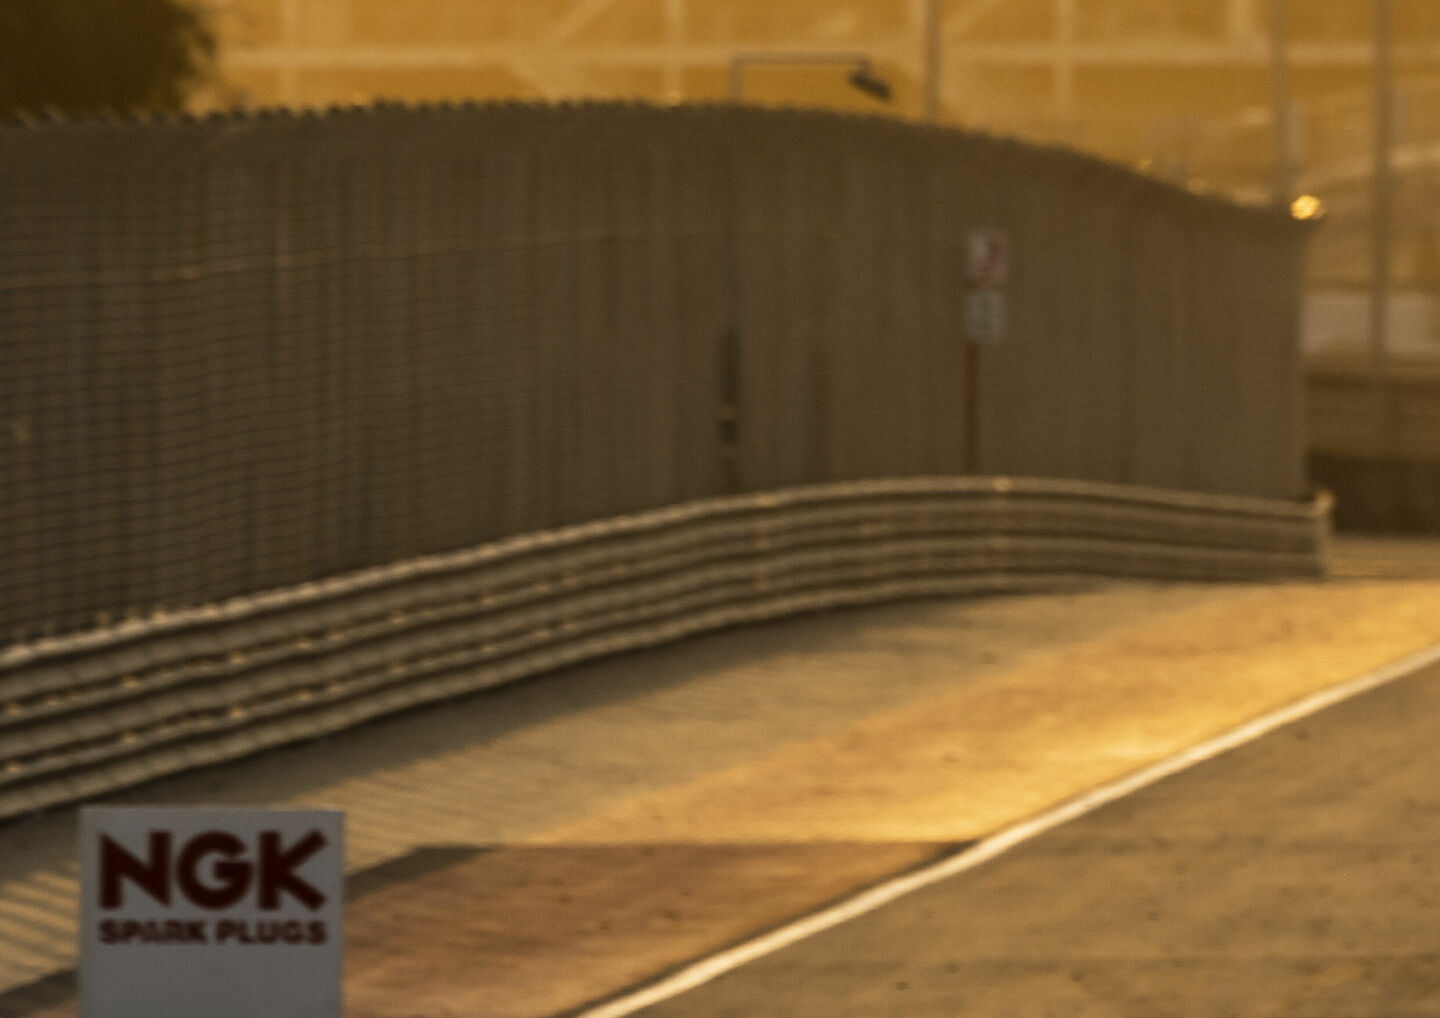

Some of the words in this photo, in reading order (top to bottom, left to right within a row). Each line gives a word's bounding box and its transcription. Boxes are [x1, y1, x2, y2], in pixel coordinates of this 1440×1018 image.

[99, 829, 327, 911] NGK
[98, 919, 206, 945] SPARK
[216, 919, 327, 945] PLUGS
